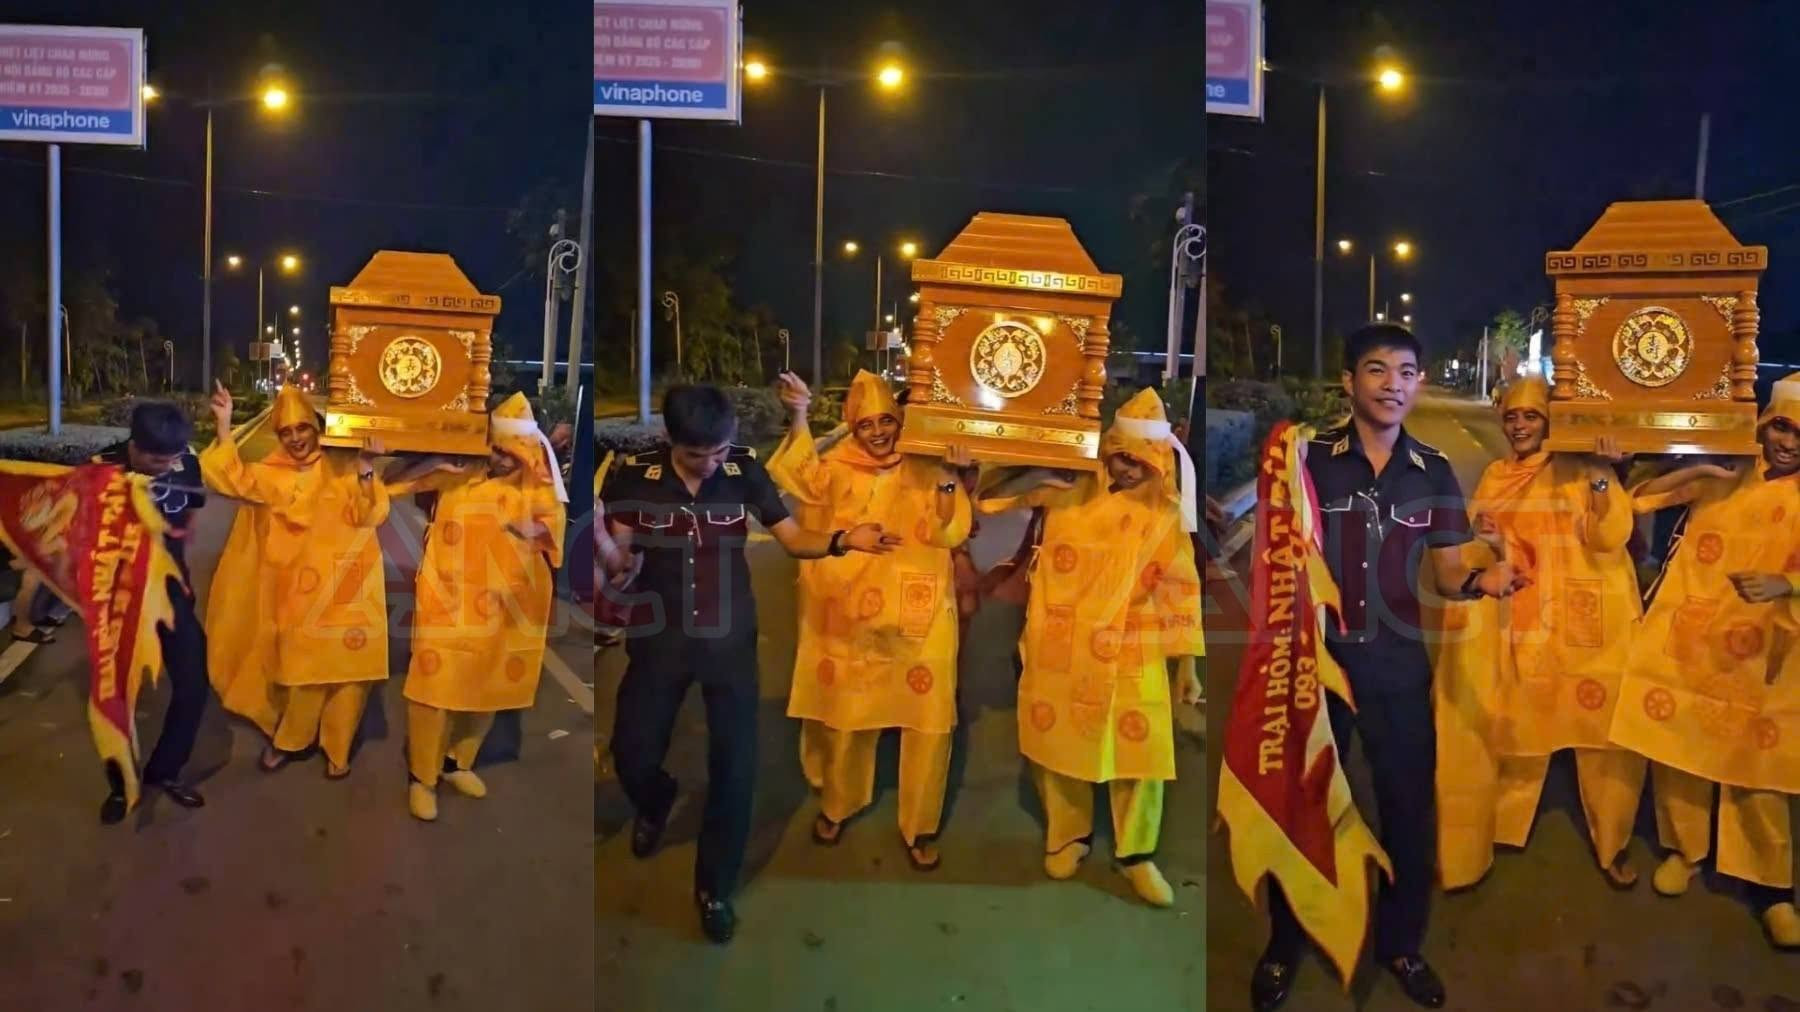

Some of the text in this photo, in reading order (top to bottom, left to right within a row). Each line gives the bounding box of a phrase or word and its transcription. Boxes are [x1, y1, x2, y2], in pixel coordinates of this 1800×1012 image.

[12, 109, 110, 129] vinaphone
[600, 83, 703, 104] vinaphone
[1261, 514, 1297, 625] NHẬT
[1294, 656, 1317, 709] 093
[1258, 704, 1291, 775] TRẠI
